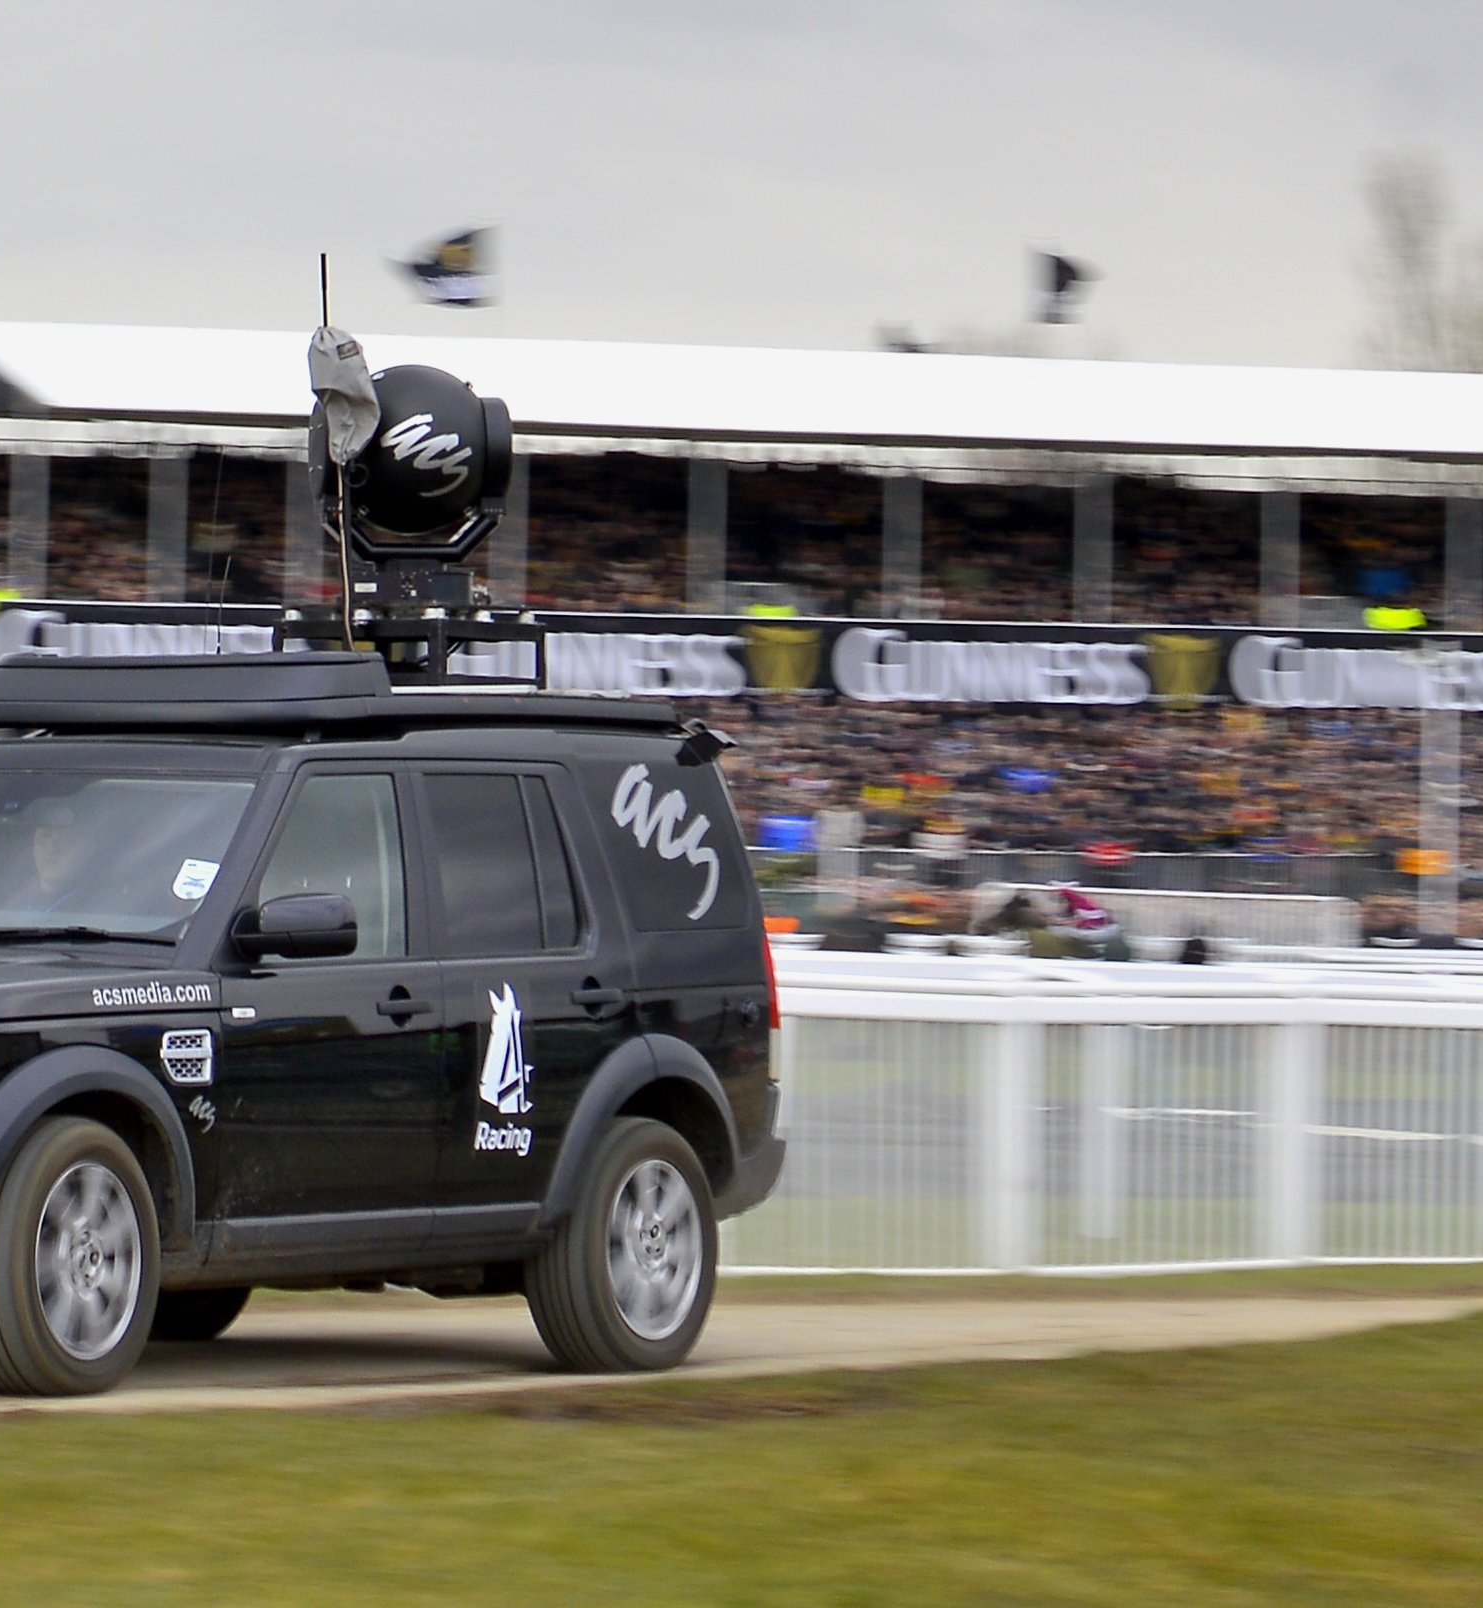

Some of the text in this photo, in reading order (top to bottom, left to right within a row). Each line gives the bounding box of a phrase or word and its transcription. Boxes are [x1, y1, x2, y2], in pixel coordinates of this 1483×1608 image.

[832, 627, 1151, 704] GUINNESS
[92, 981, 212, 1006] acsmedia.com
[473, 1121, 532, 1157] Racing
